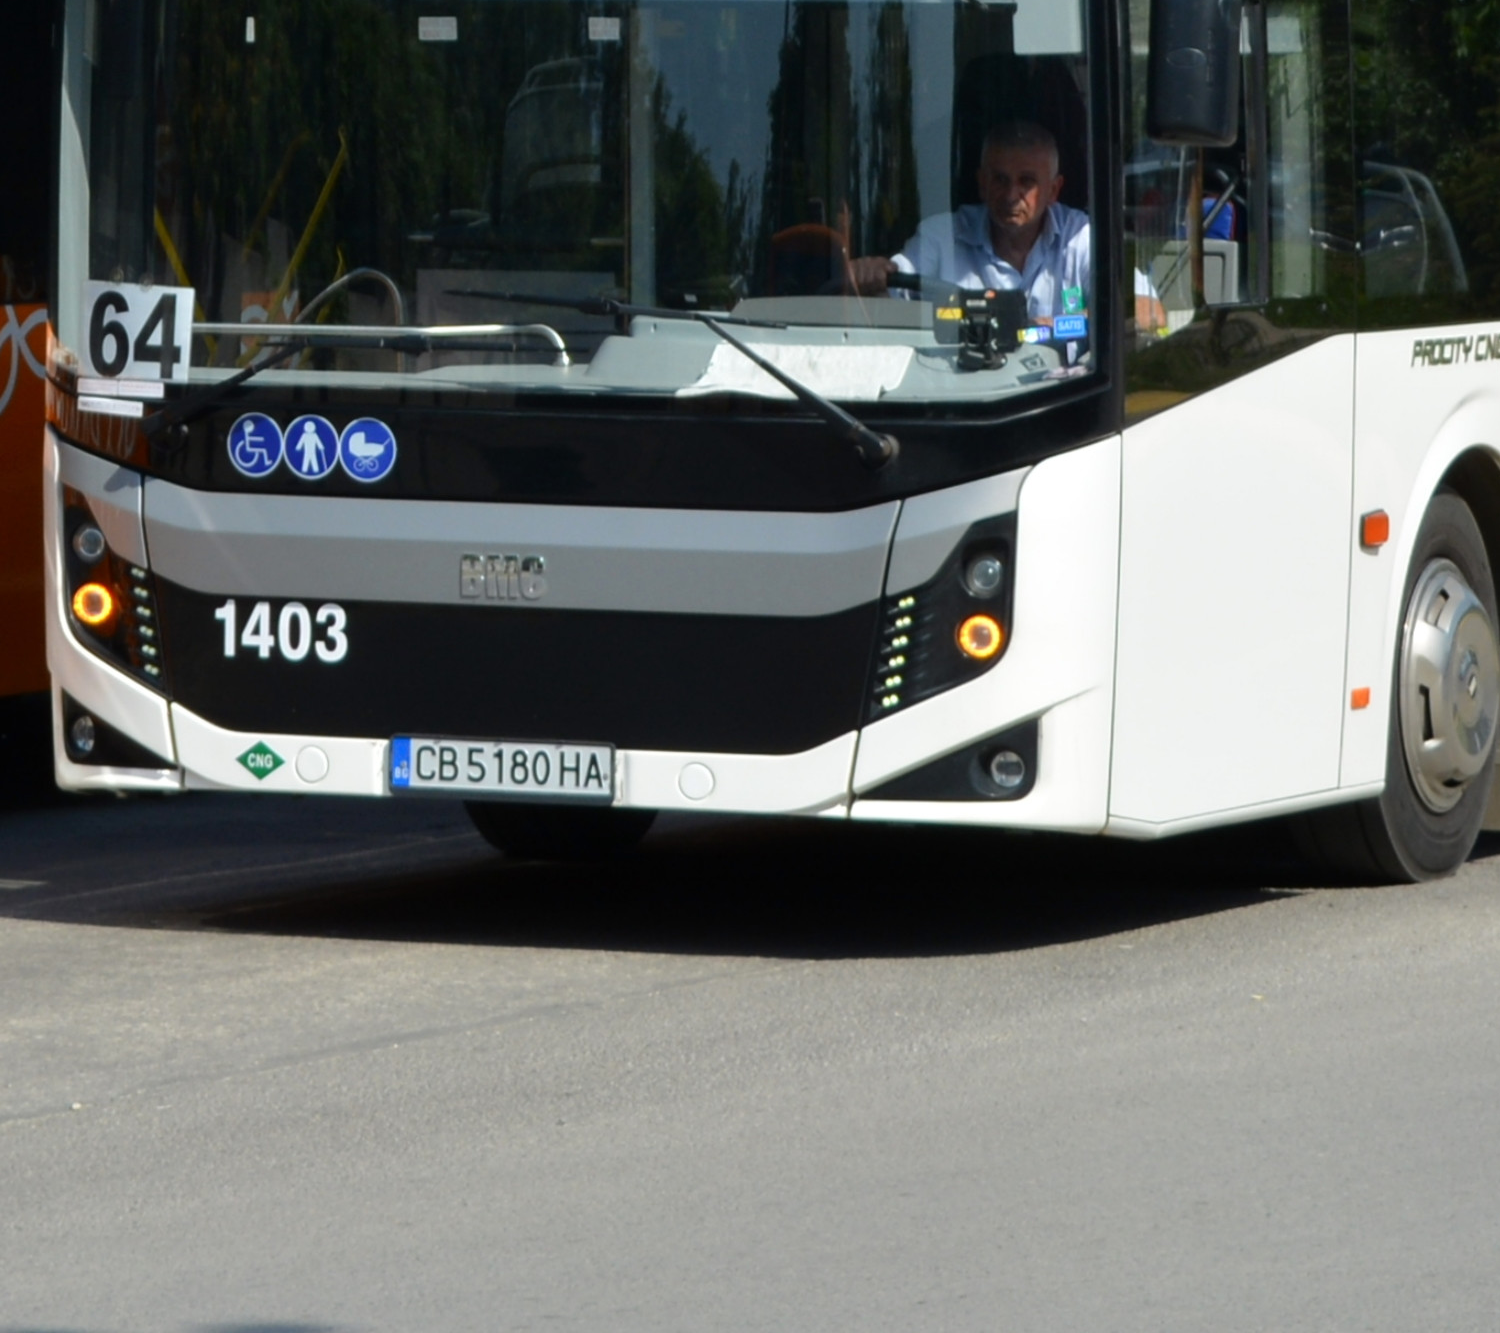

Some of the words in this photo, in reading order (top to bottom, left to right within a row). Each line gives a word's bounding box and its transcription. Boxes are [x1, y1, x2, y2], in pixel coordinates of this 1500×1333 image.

[88, 289, 182, 379] 64
[459, 553, 547, 601] BMC
[214, 598, 349, 663] 1403
[247, 752, 274, 769] CNG
[415, 745, 459, 782] CB
[467, 747, 550, 786] 5180
[559, 751, 604, 788] HA
